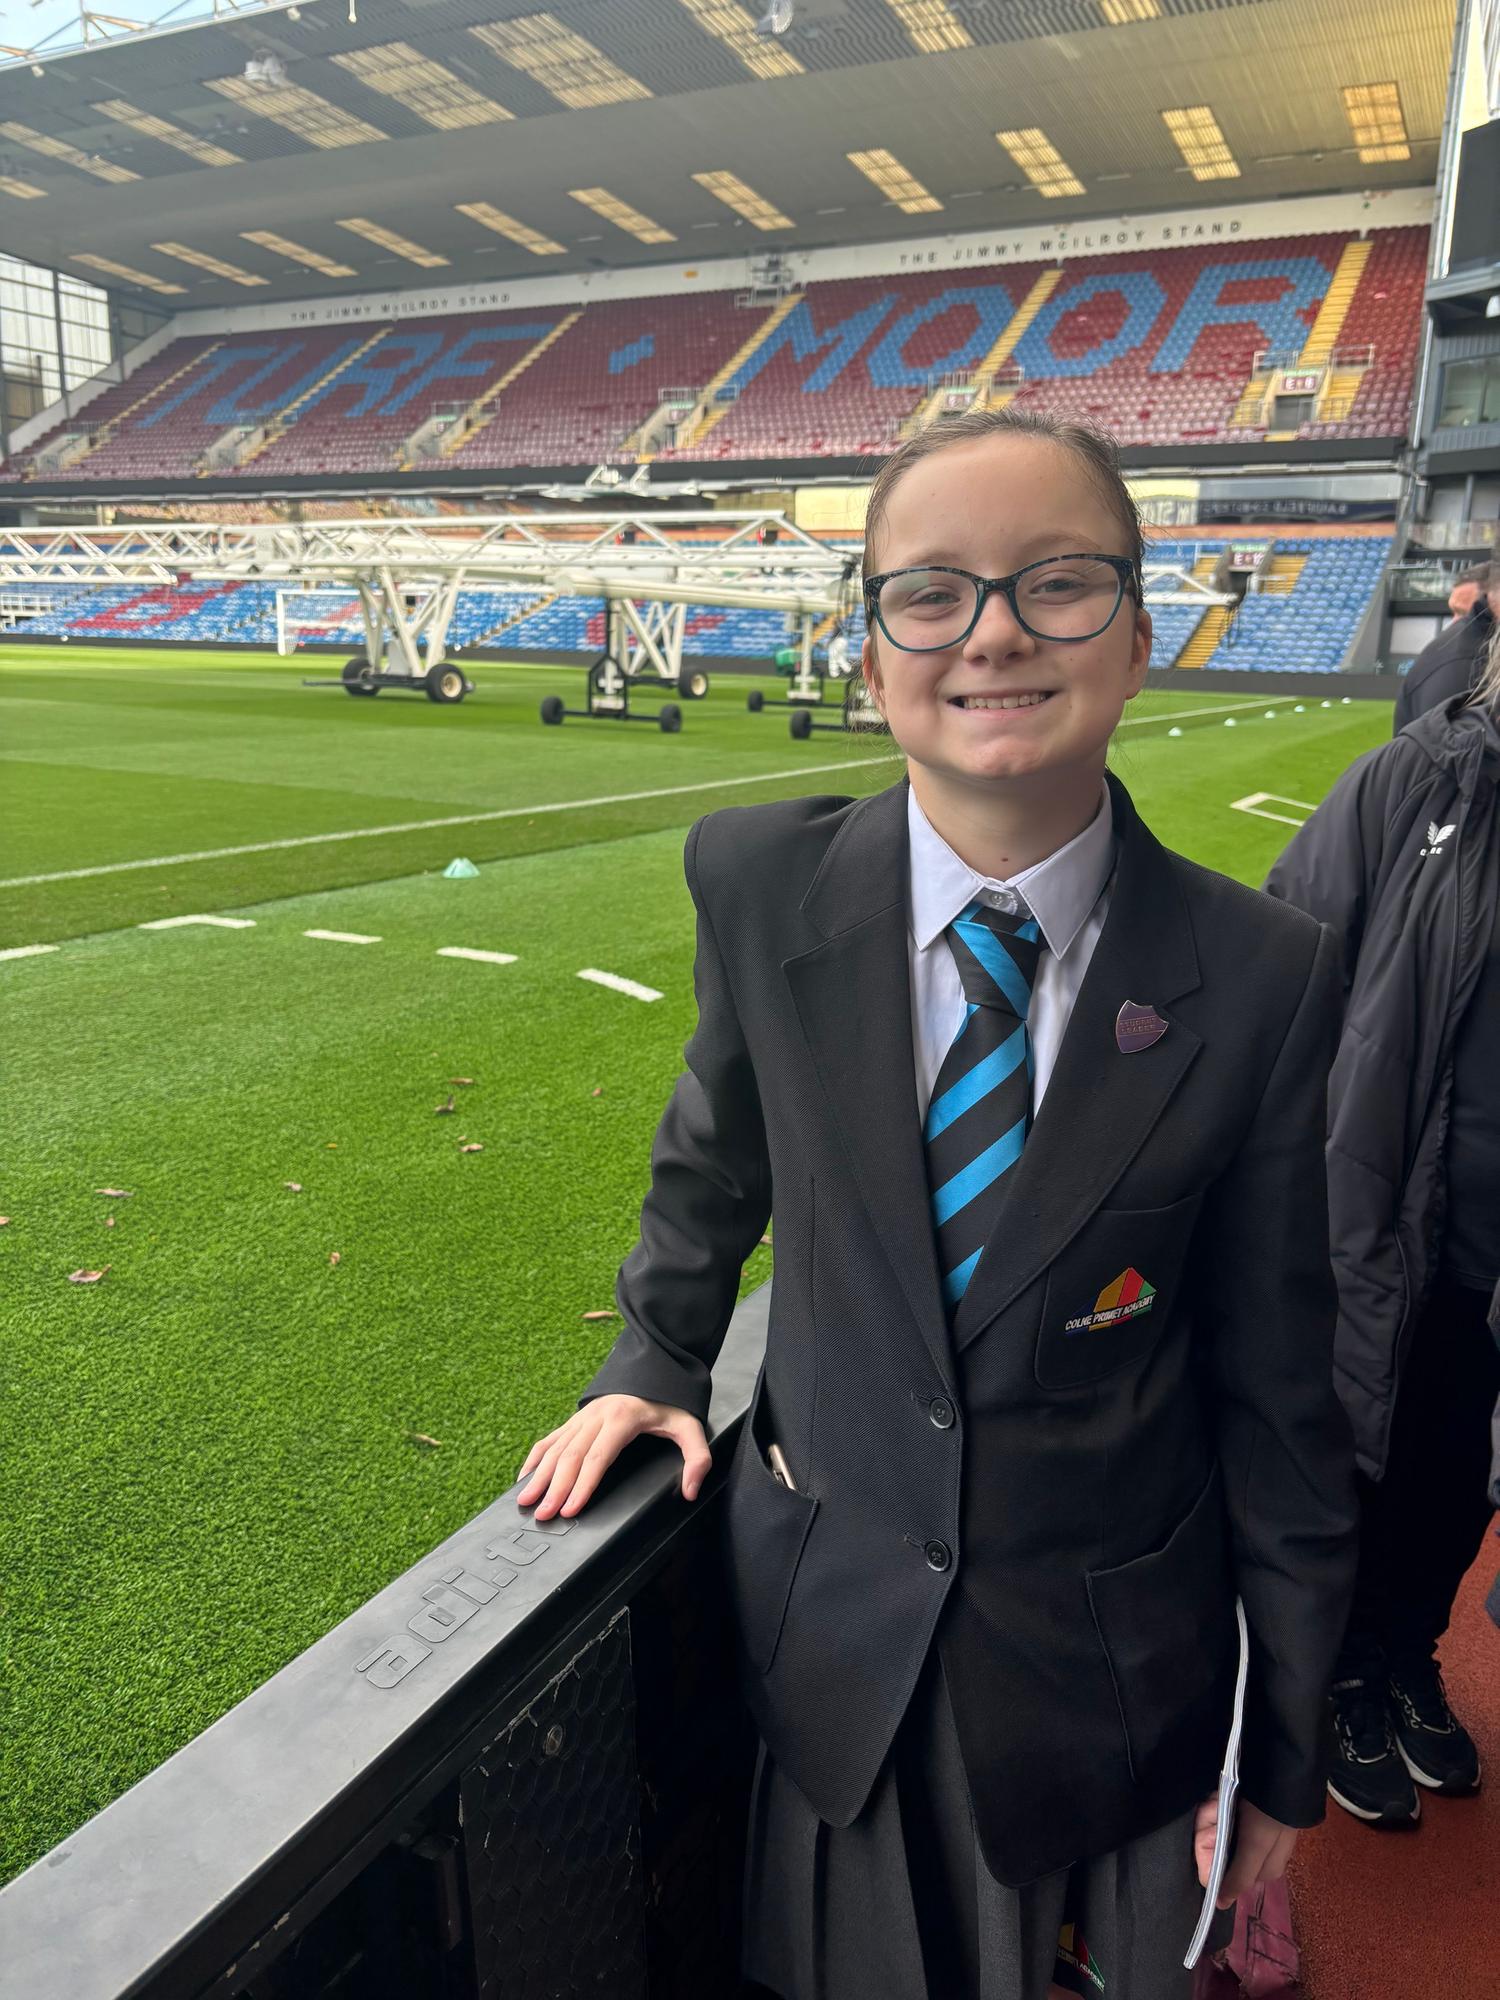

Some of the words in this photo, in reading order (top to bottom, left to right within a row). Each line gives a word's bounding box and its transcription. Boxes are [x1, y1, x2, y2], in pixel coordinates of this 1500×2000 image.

[899, 252, 937, 266] THE
[953, 243, 1024, 261] JIMMY
[1162, 220, 1242, 240] STAND
[135, 322, 552, 429] TURF
[728, 256, 1335, 394] MOOR
[1065, 1314, 1093, 1331] COLNE
[1092, 1306, 1123, 1324] PRIMET
